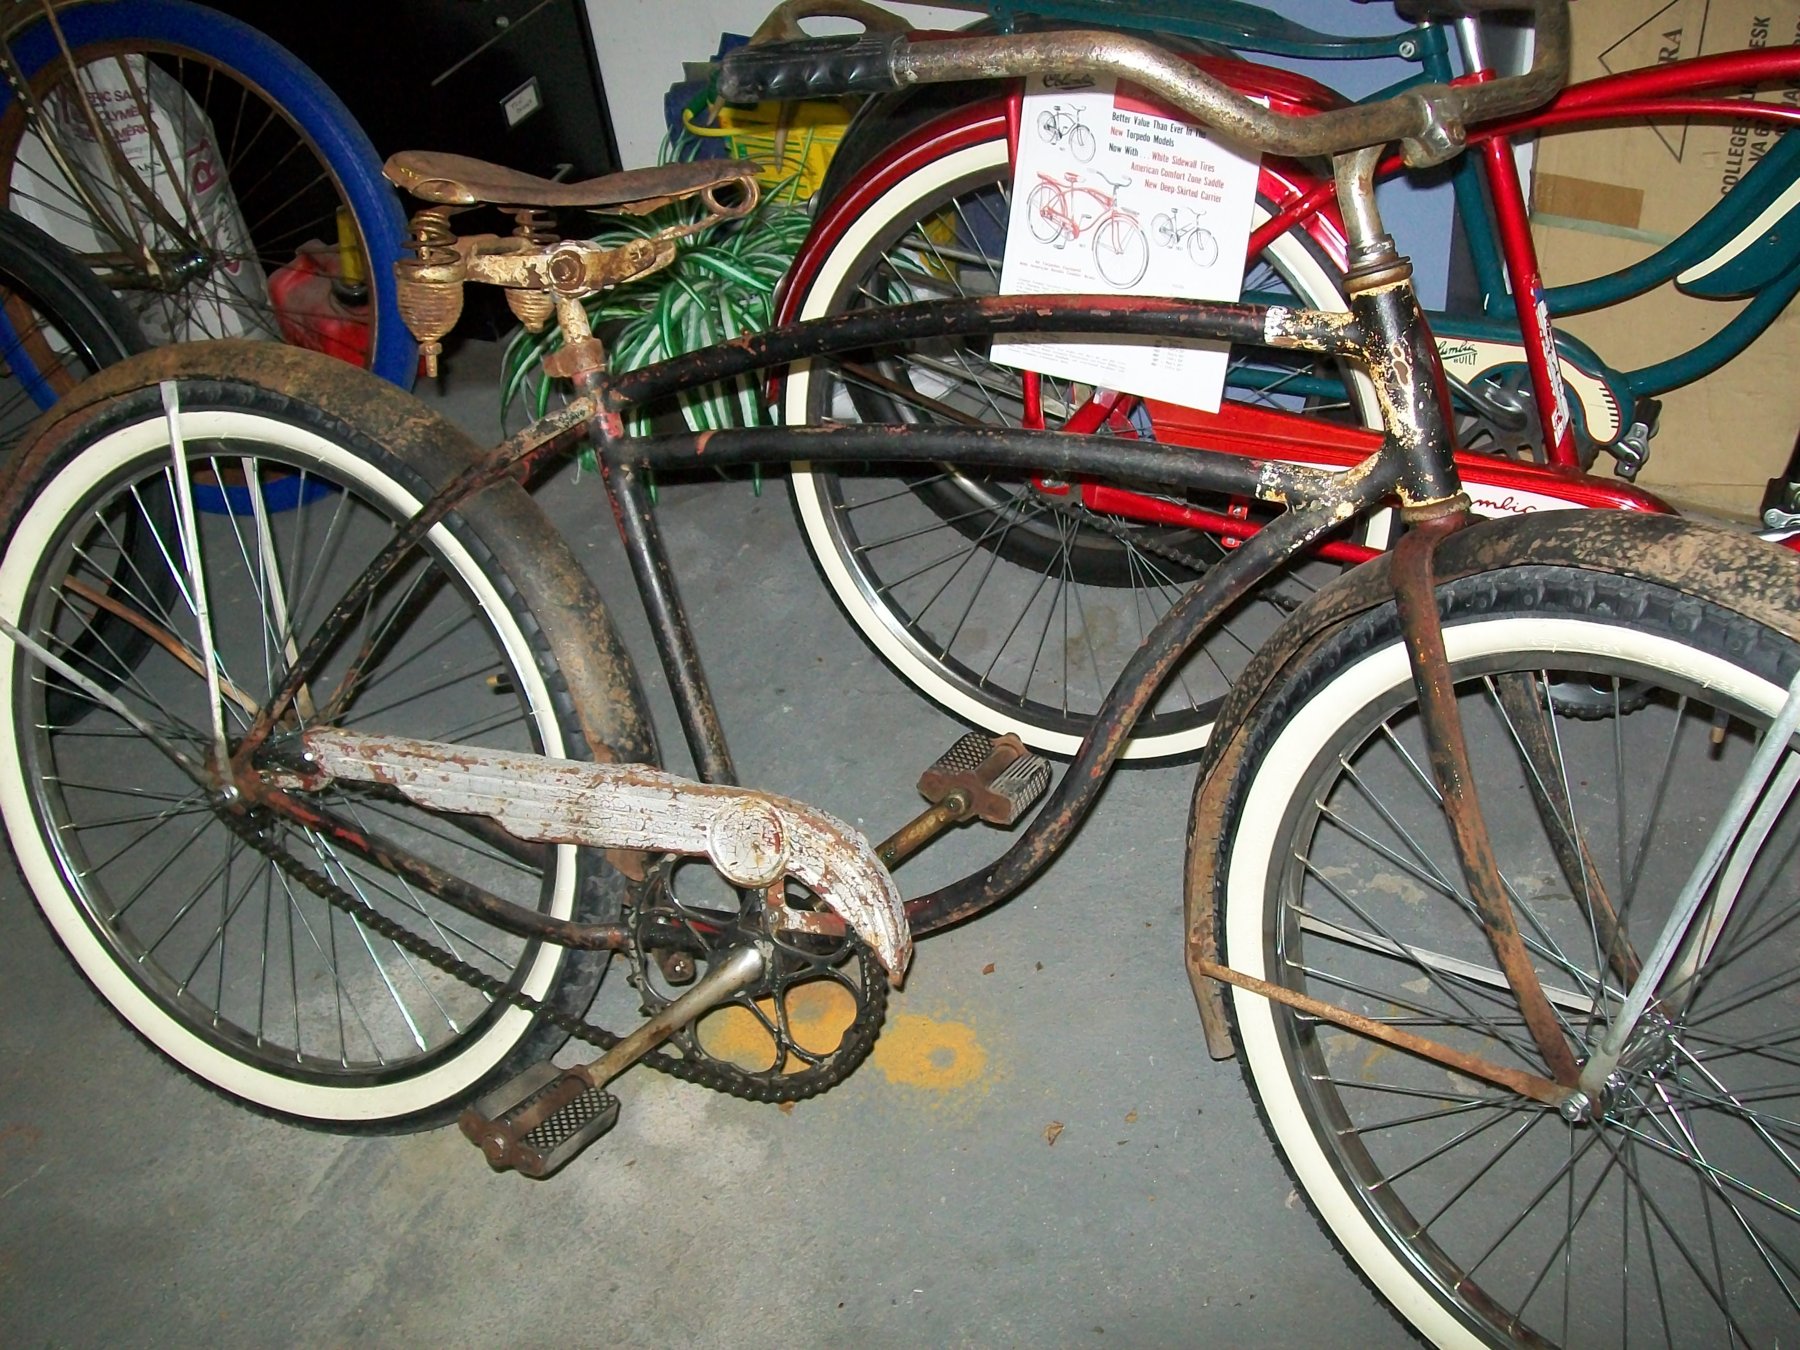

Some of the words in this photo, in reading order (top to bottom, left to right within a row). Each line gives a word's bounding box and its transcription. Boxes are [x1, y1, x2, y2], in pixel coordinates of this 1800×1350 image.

[1721, 122, 1749, 195] COLLEGE
[1749, 16, 1771, 49] ESK
[1112, 112, 1130, 124] Better
[1134, 115, 1150, 128] Value
[1153, 119, 1168, 131] Than
[1170, 123, 1184, 135] Ever
[1186, 126, 1193, 136] In
[1110, 126, 1123, 137] New
[1126, 129, 1151, 142] Torpedo
[1153, 135, 1175, 147] Models
[1109, 143, 1121, 153] Now
[1125, 145, 1139, 157] With
[1152, 151, 1169, 163] White
[1172, 155, 1197, 169] Sidewall
[1200, 161, 1215, 173] Tires
[1131, 161, 1159, 176] American
[1160, 168, 1185, 181] Comfort
[1187, 173, 1201, 185] Zone
[1203, 177, 1224, 189] Saddle
[1144, 179, 1157, 189] New
[1160, 182, 1175, 195] Deep
[1177, 185, 1198, 199] Skirted
[1200, 191, 1222, 203] Carrier
[1437, 340, 1477, 356] lumbia
[1453, 353, 1478, 366] BUILT
